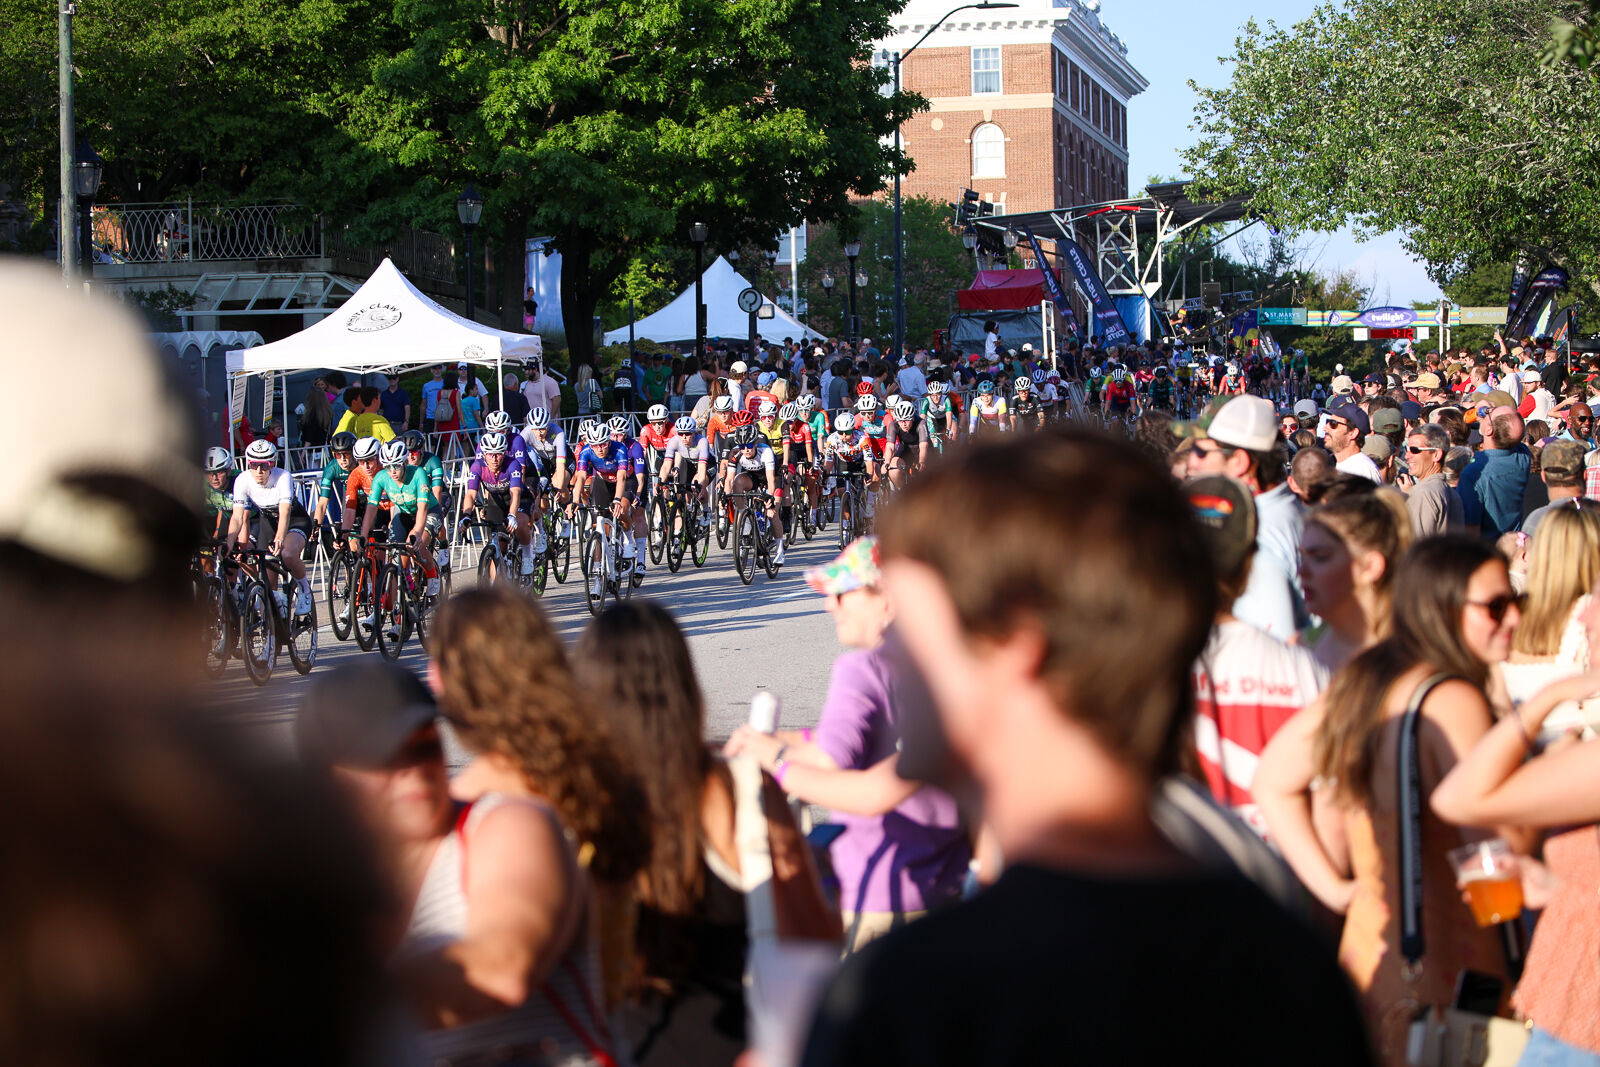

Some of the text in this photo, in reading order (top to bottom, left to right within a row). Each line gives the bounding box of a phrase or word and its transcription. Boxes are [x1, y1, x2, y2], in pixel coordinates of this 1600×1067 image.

[346, 309, 367, 327] WHITE
[369, 303, 400, 311] CLAW
[1371, 312, 1405, 323] twilight
[1393, 328, 1414, 338] 4:12
